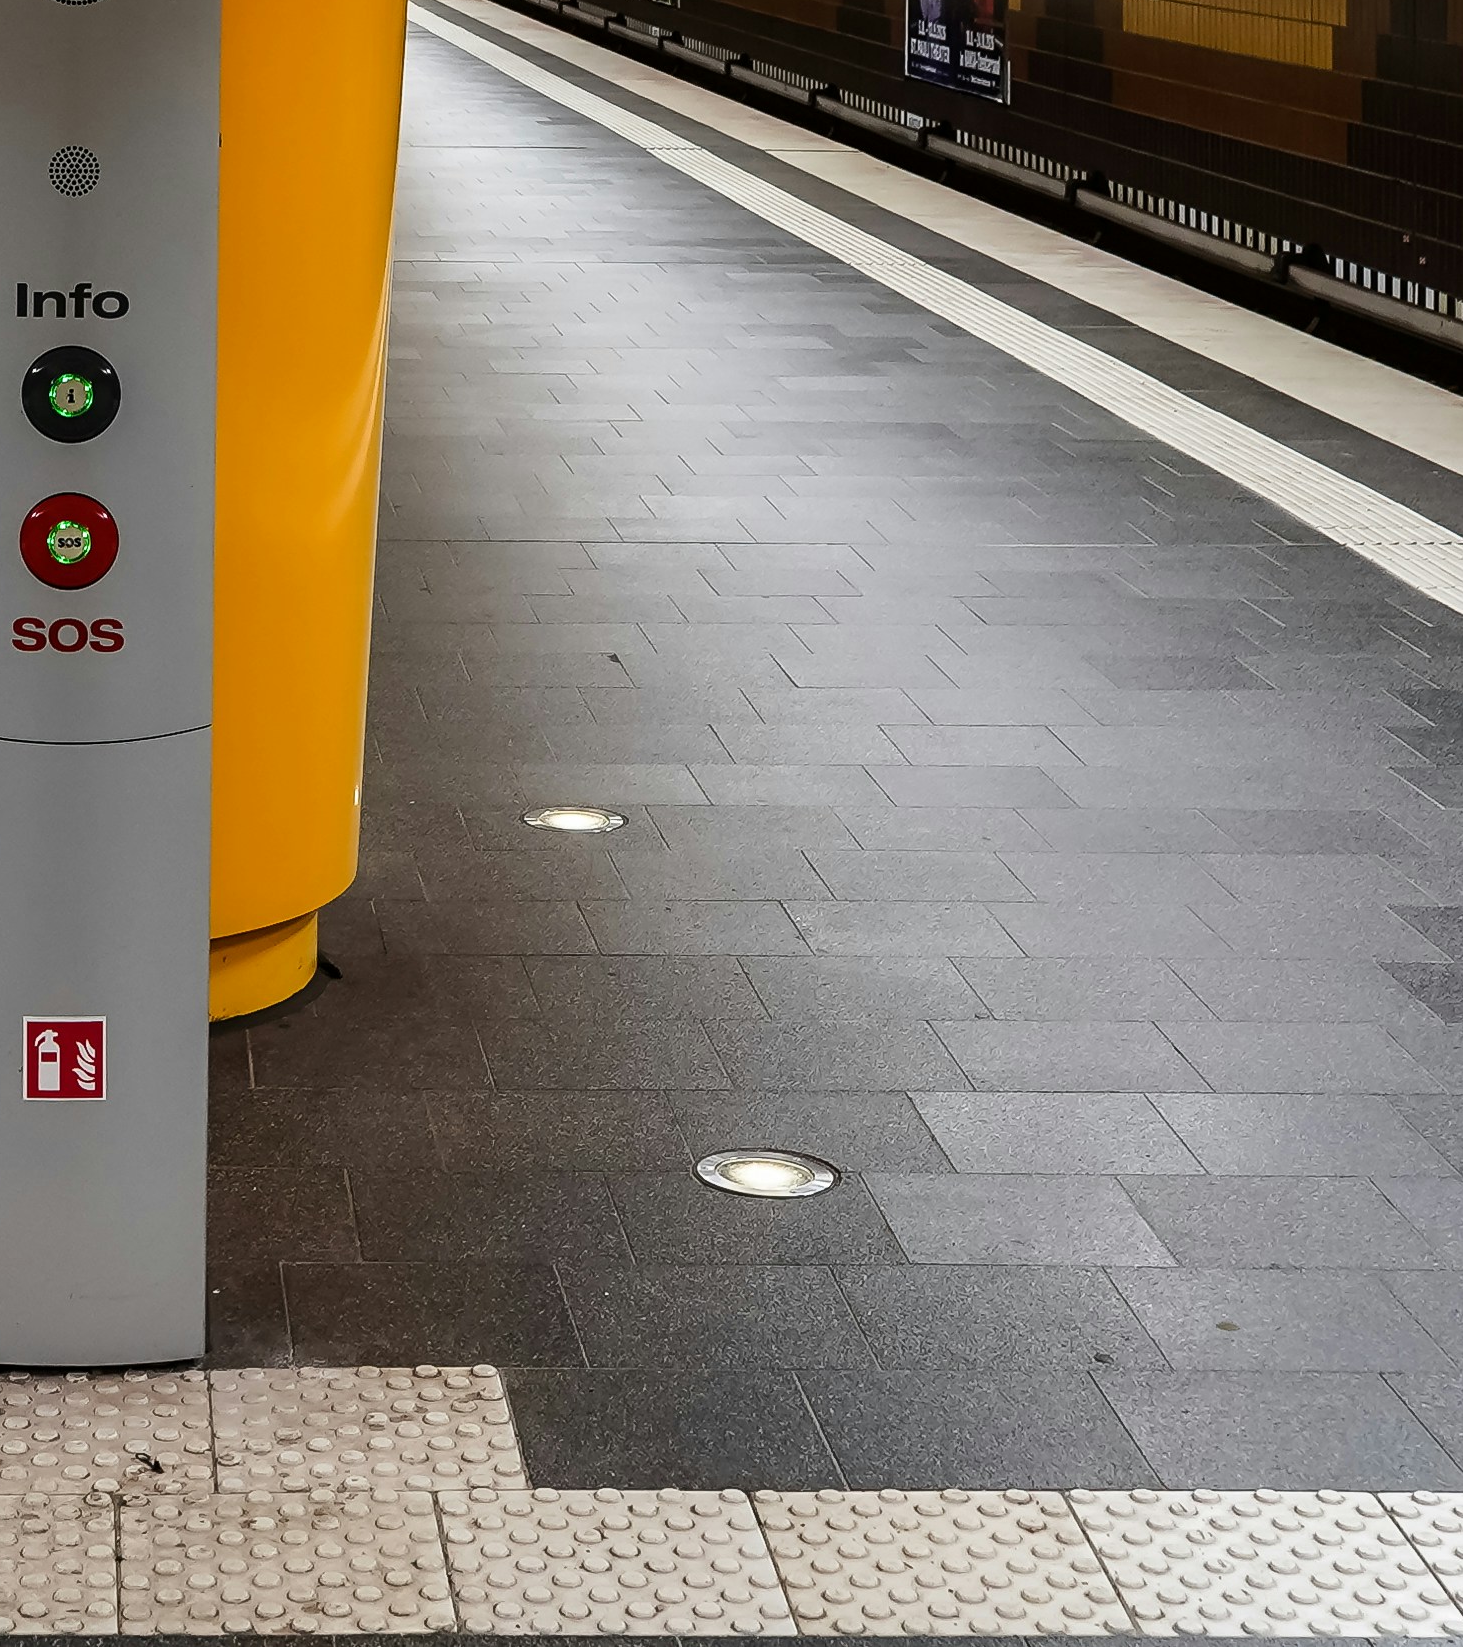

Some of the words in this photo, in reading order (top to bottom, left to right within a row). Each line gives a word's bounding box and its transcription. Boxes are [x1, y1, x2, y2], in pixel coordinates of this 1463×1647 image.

[15, 282, 131, 320] Info
[56, 536, 82, 549] SOS
[11, 616, 126, 654] SOS
